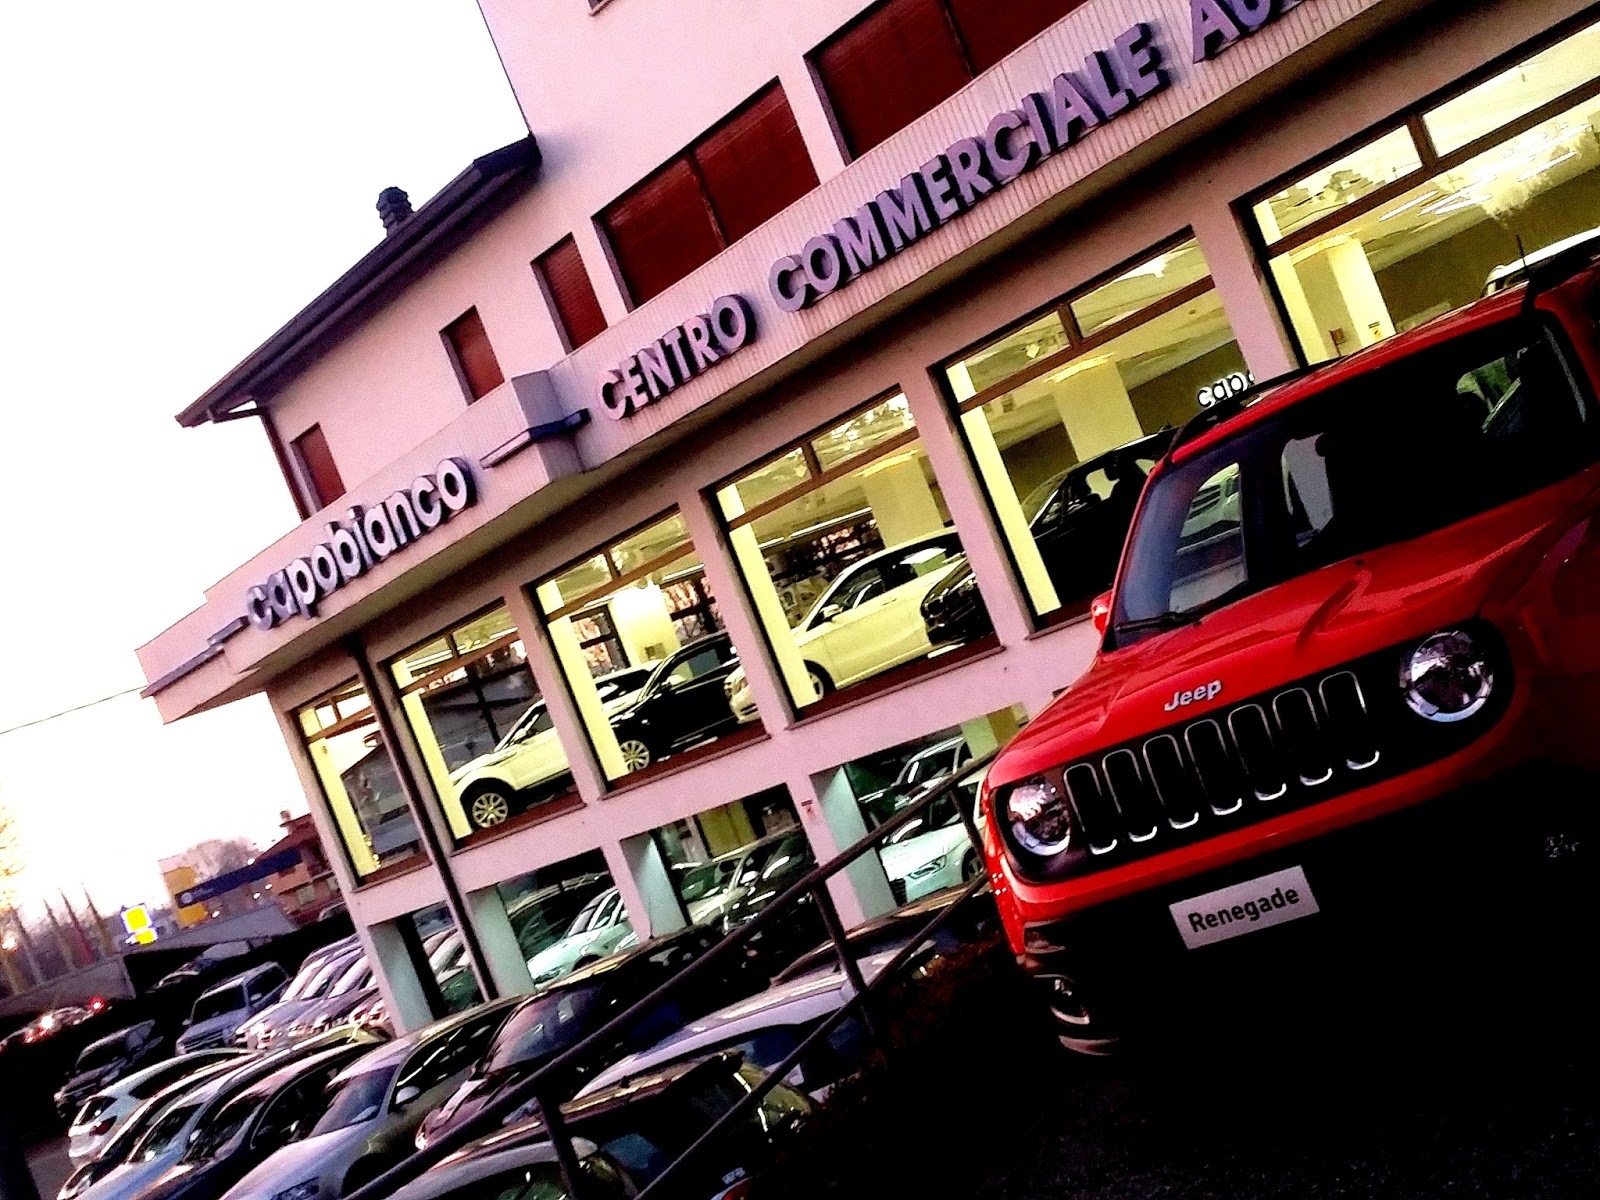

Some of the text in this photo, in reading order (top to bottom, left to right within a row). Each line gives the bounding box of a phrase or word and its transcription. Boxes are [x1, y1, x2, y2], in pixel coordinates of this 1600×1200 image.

[597, 0, 1292, 420] CENTRO COMMERCIALE AU
[1198, 372, 1255, 408] cap
[248, 457, 476, 631] capobianco
[1164, 680, 1222, 712] Jeep
[1187, 887, 1301, 934] Renegade
